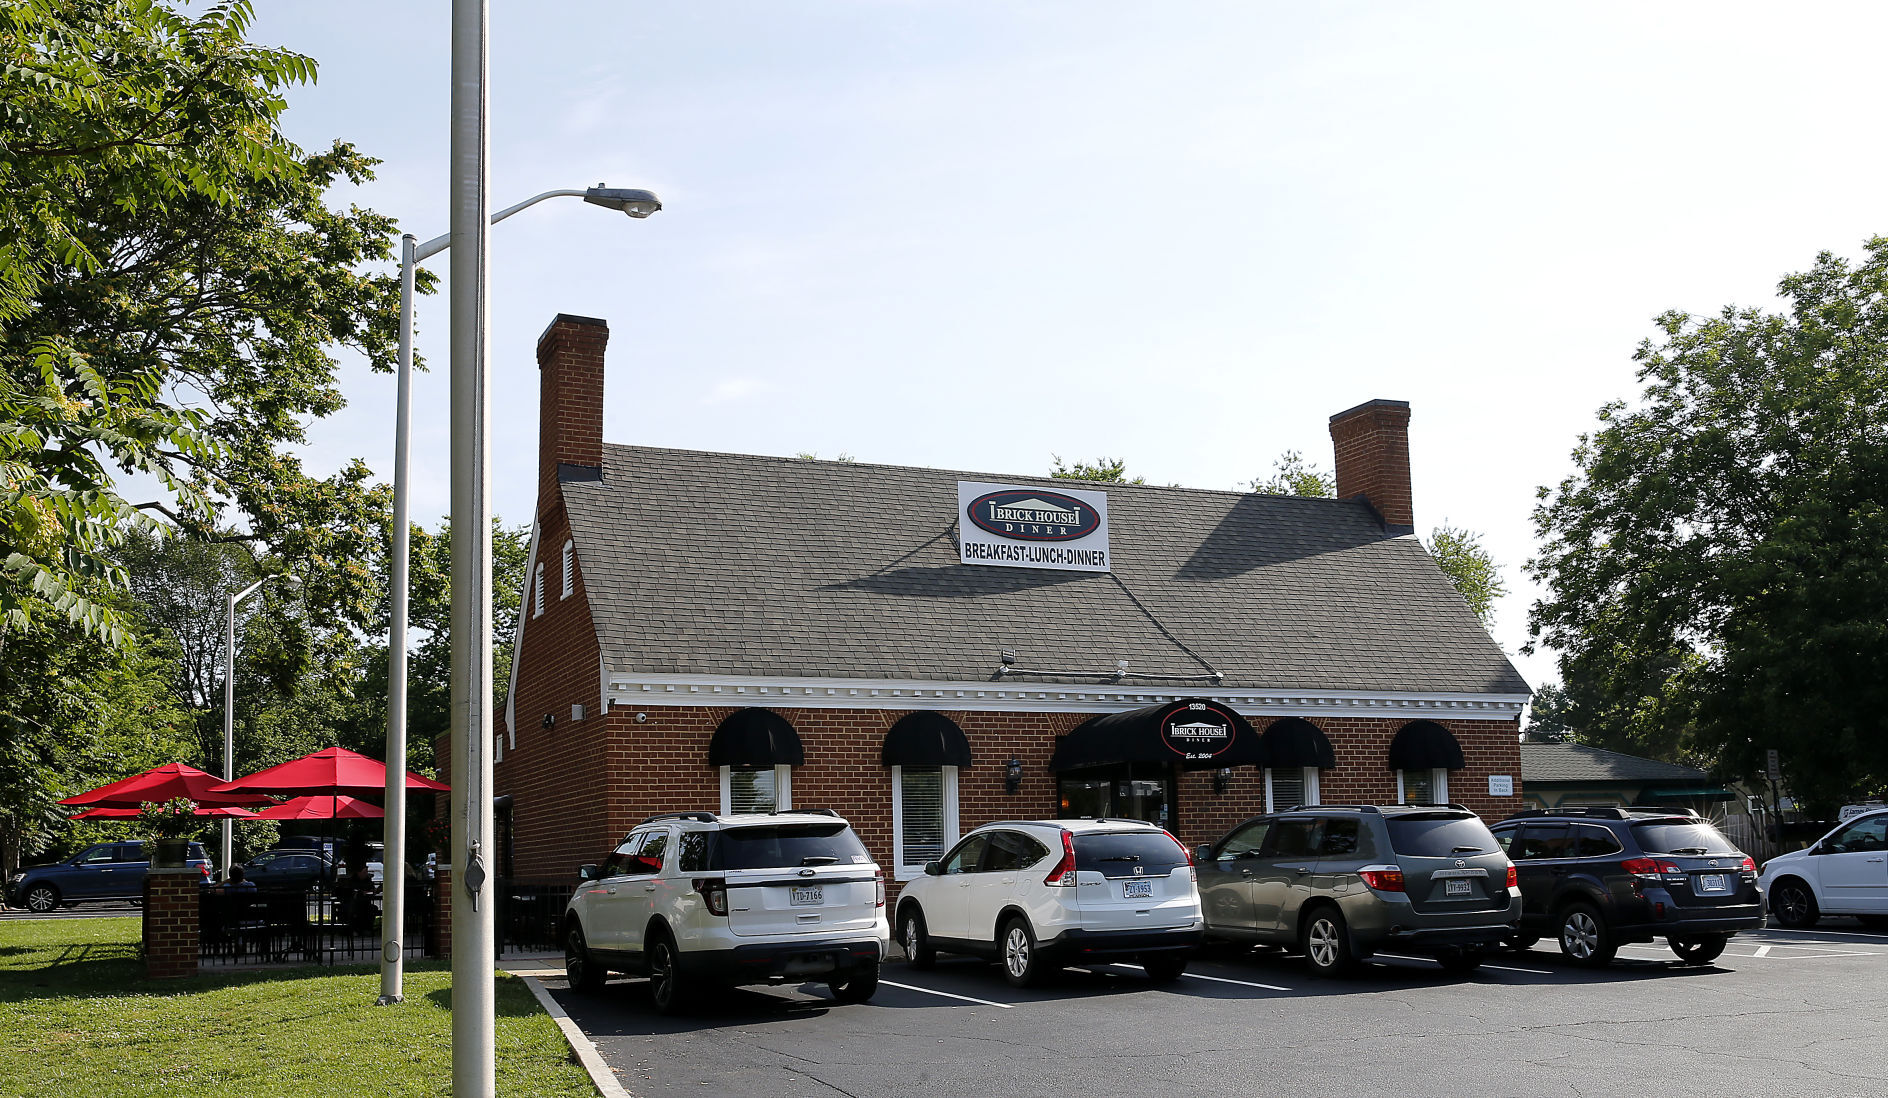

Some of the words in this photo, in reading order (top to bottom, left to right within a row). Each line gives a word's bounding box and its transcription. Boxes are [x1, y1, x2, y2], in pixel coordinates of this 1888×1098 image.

[996, 508, 1032, 521] BRICK
[1035, 511, 1075, 524] HOUSE
[1005, 523, 1067, 535] DINER
[1174, 727, 1197, 735] BRICK
[1198, 728, 1224, 736] HOUSE
